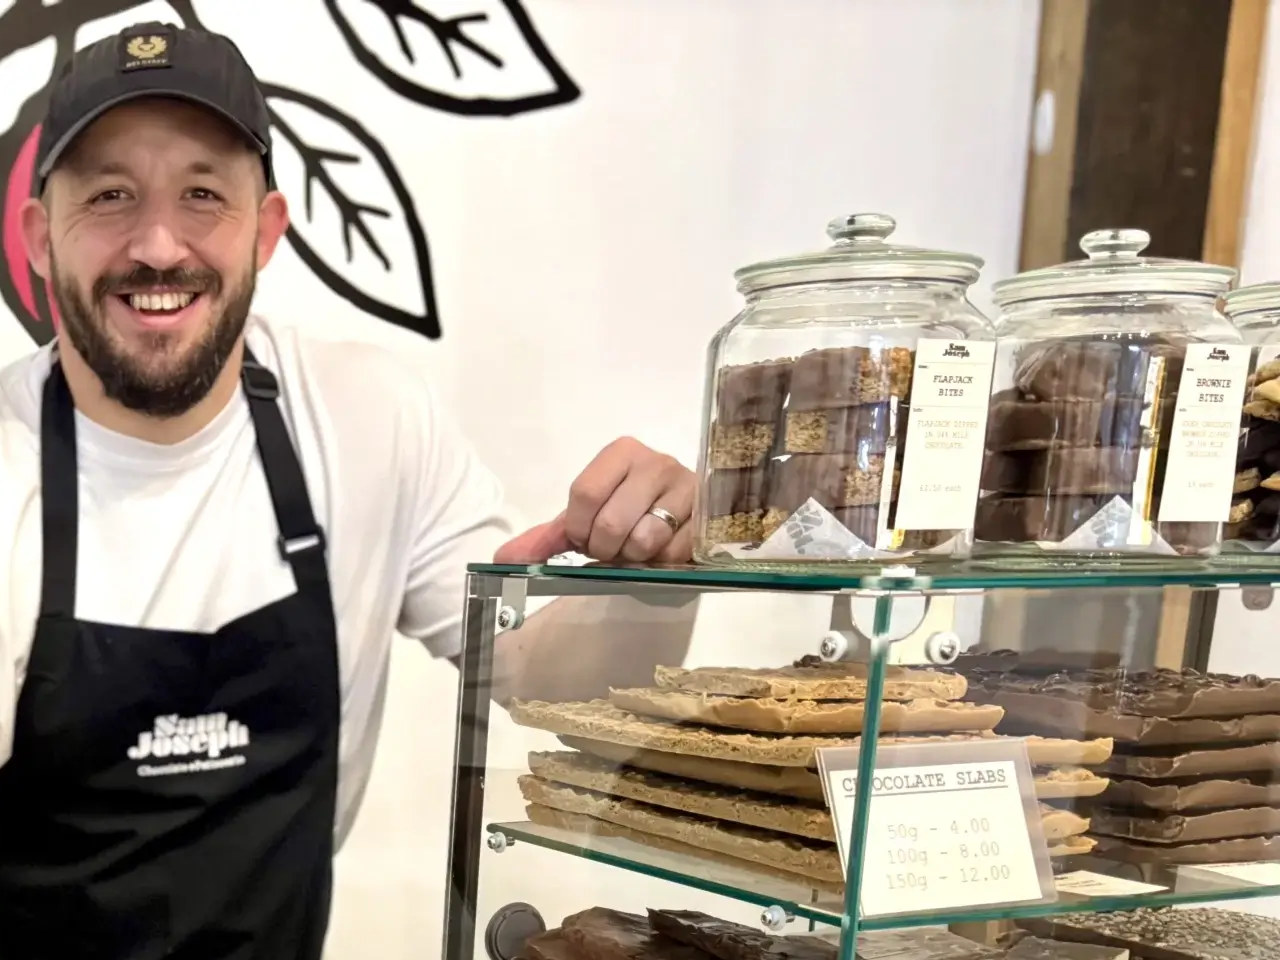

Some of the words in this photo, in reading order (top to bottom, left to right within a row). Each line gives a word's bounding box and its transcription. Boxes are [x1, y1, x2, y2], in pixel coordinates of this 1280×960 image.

[933, 375, 973, 384] FLAPJACK
[1196, 378, 1231, 388] BROWNIE
[1199, 394, 1224, 402] BITES
[154, 712, 228, 737] Sam
[127, 720, 250, 759] Joseph
[842, 773, 946, 792] COCOLATE
[956, 769, 1006, 785] SLABS
[887, 824, 918, 842] 50g
[950, 818, 990, 835] 4.00
[887, 849, 928, 866] 100g
[959, 841, 1000, 858] 8.00
[886, 873, 928, 891] 150g
[960, 865, 1011, 883] 12.00
